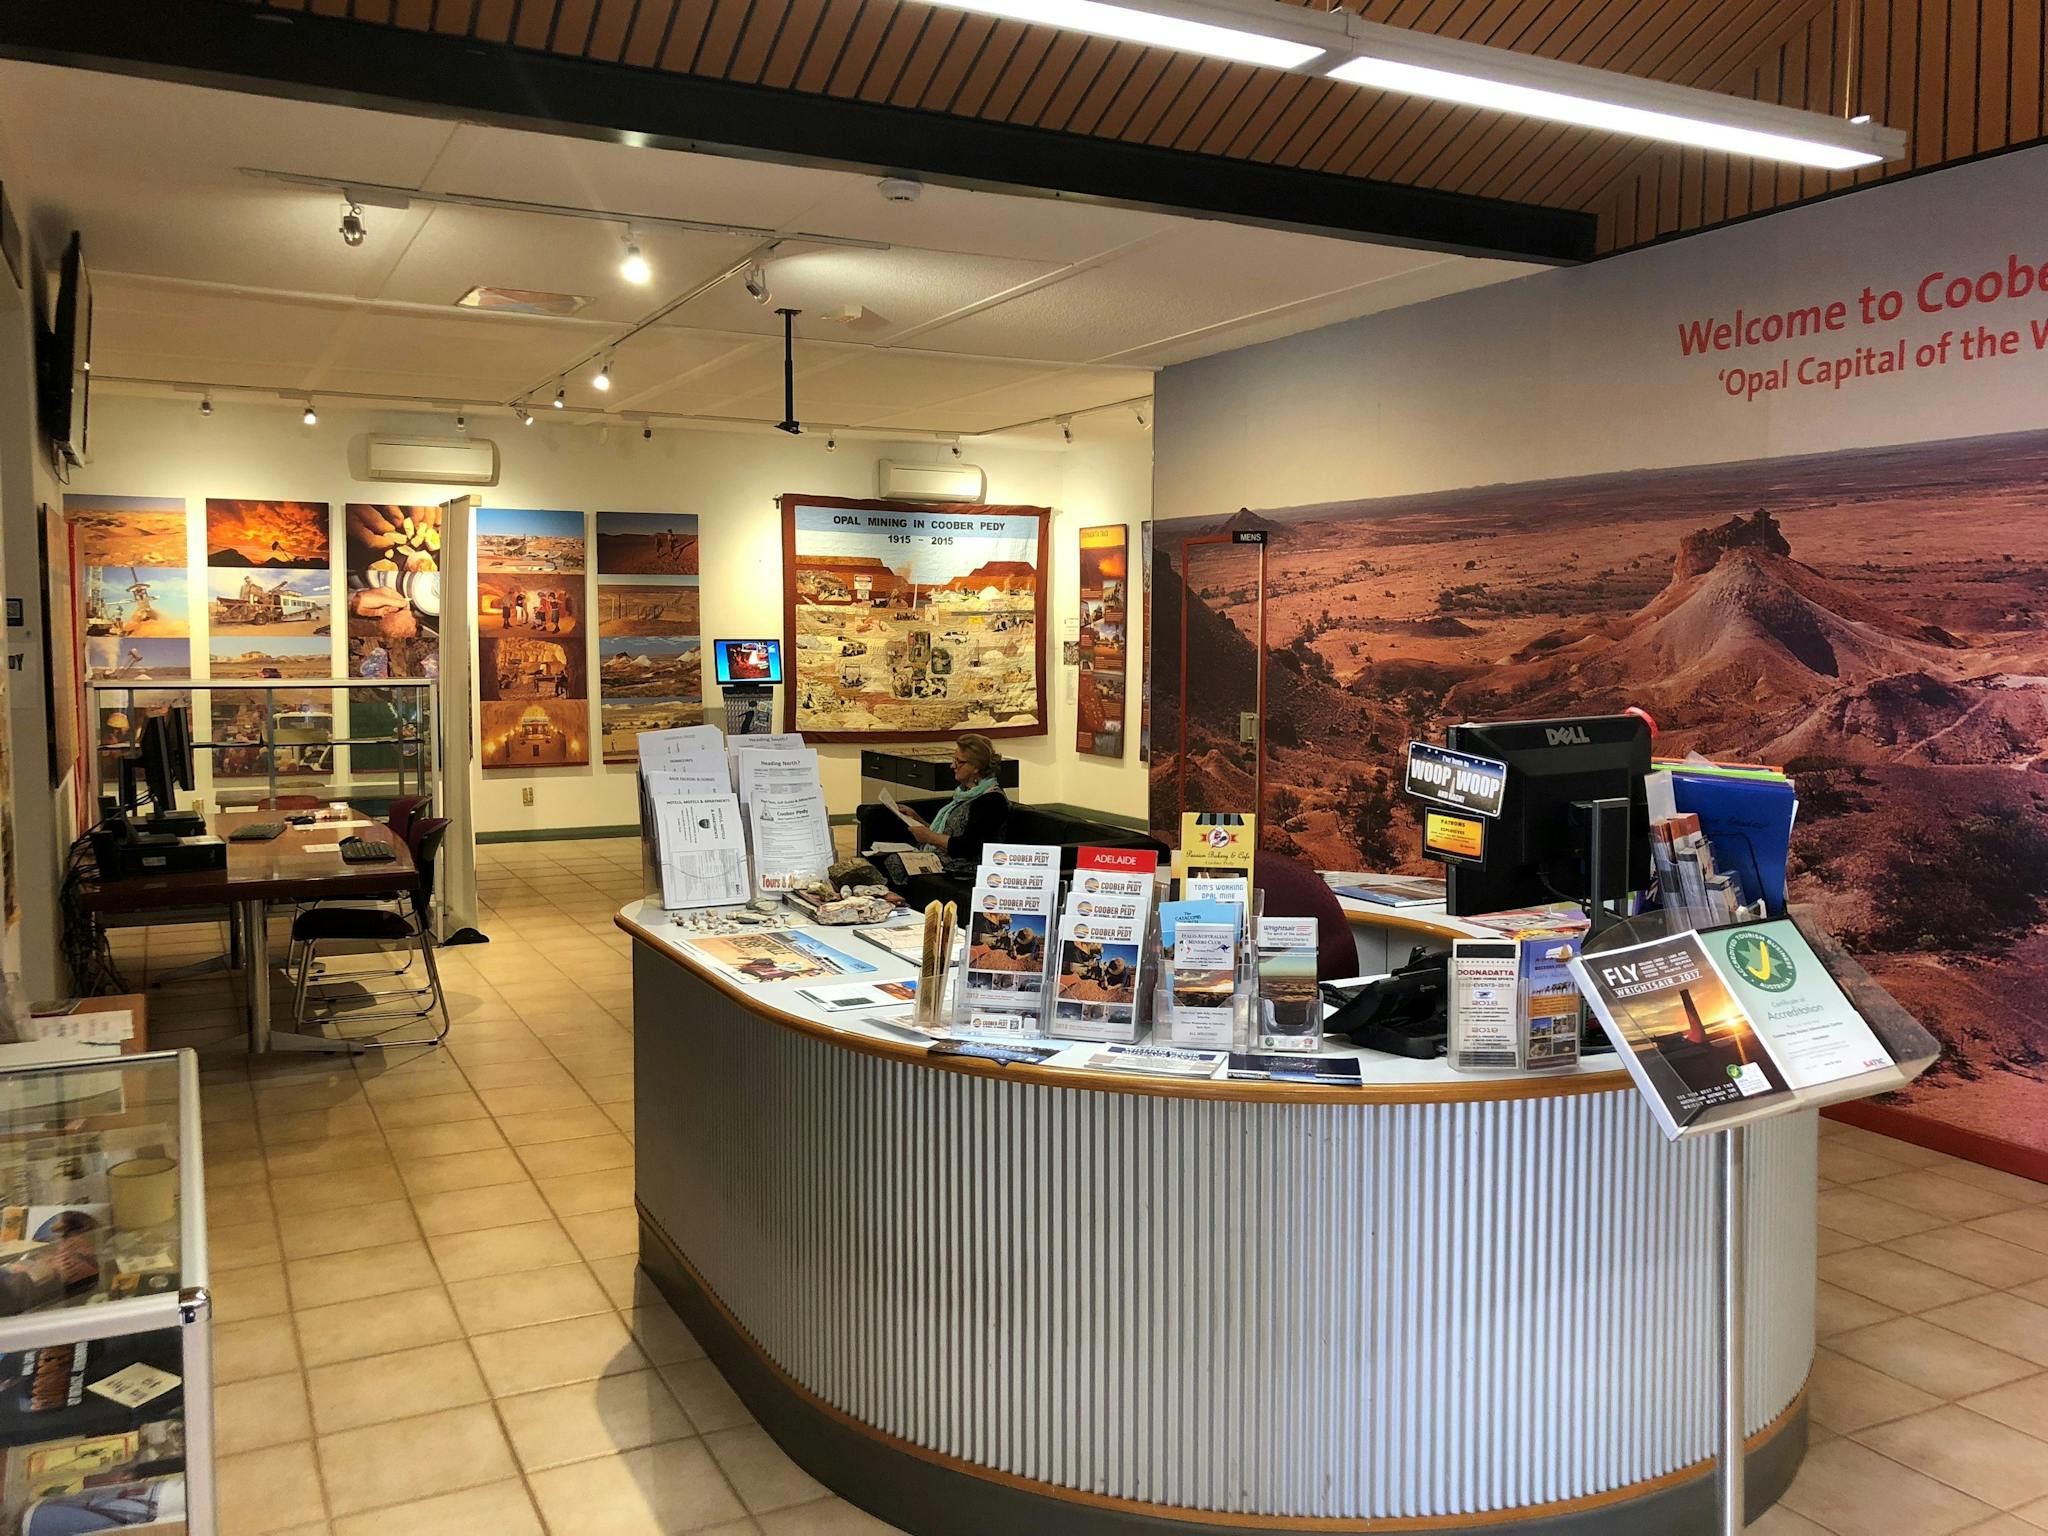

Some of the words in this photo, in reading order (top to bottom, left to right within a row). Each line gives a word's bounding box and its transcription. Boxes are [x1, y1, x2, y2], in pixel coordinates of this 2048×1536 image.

[1678, 302, 1846, 356] Welcome
[1858, 287, 1903, 324] to
[1798, 340, 1904, 389] Capital
[1916, 332, 1953, 367] of
[1960, 326, 2020, 360] the
[833, 516, 861, 525] OPAL
[868, 518, 907, 528] MINING
[914, 520, 924, 528] IN
[931, 521, 973, 530] COOBER
[981, 522, 1005, 531] PEDY
[888, 536, 911, 544] 1915
[931, 537, 953, 545] 2015
[1240, 533, 1261, 541] MENS
[1545, 726, 1590, 745] DELL
[1411, 758, 1452, 786] WOOP
[1456, 770, 1500, 798] WOOP
[1009, 854, 1033, 862] COOBER
[1094, 854, 1136, 865] ADELAIDE
[762, 874, 780, 888] Tours
[1101, 882, 1125, 890] COOBER
[999, 899, 1023, 907] COOBER
[1094, 906, 1118, 914] COOBER
[1090, 928, 1115, 936] COOBER
[1117, 929, 1132, 937] PEDY
[1735, 933, 1765, 941] TOURISM
[1729, 939, 1748, 977] ACCREDITED
[1767, 939, 1793, 969] BUSINESS
[1602, 963, 1639, 986] FLY
[1615, 979, 1674, 996] WRIGHTSAIR
[1680, 970, 1700, 982] 2017
[1768, 1005, 1824, 1021] Accreditation
